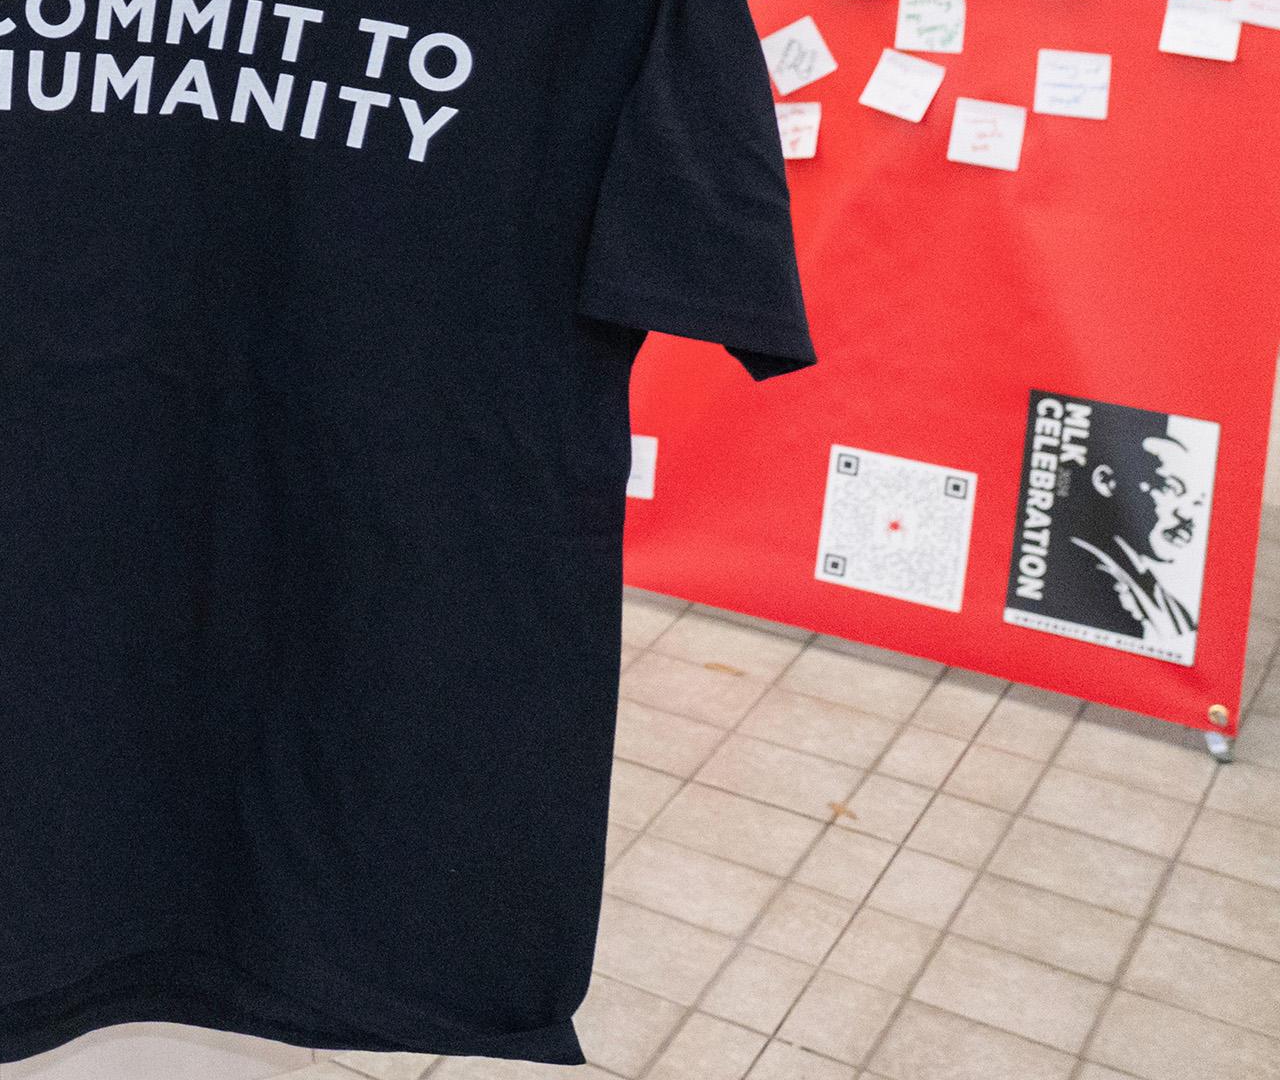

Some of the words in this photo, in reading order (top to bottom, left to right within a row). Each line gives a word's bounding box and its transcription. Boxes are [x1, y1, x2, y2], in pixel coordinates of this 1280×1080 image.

[359, 18, 473, 92] TO
[1059, 402, 1092, 468] MLK
[1016, 398, 1064, 600] CELEBRATION
